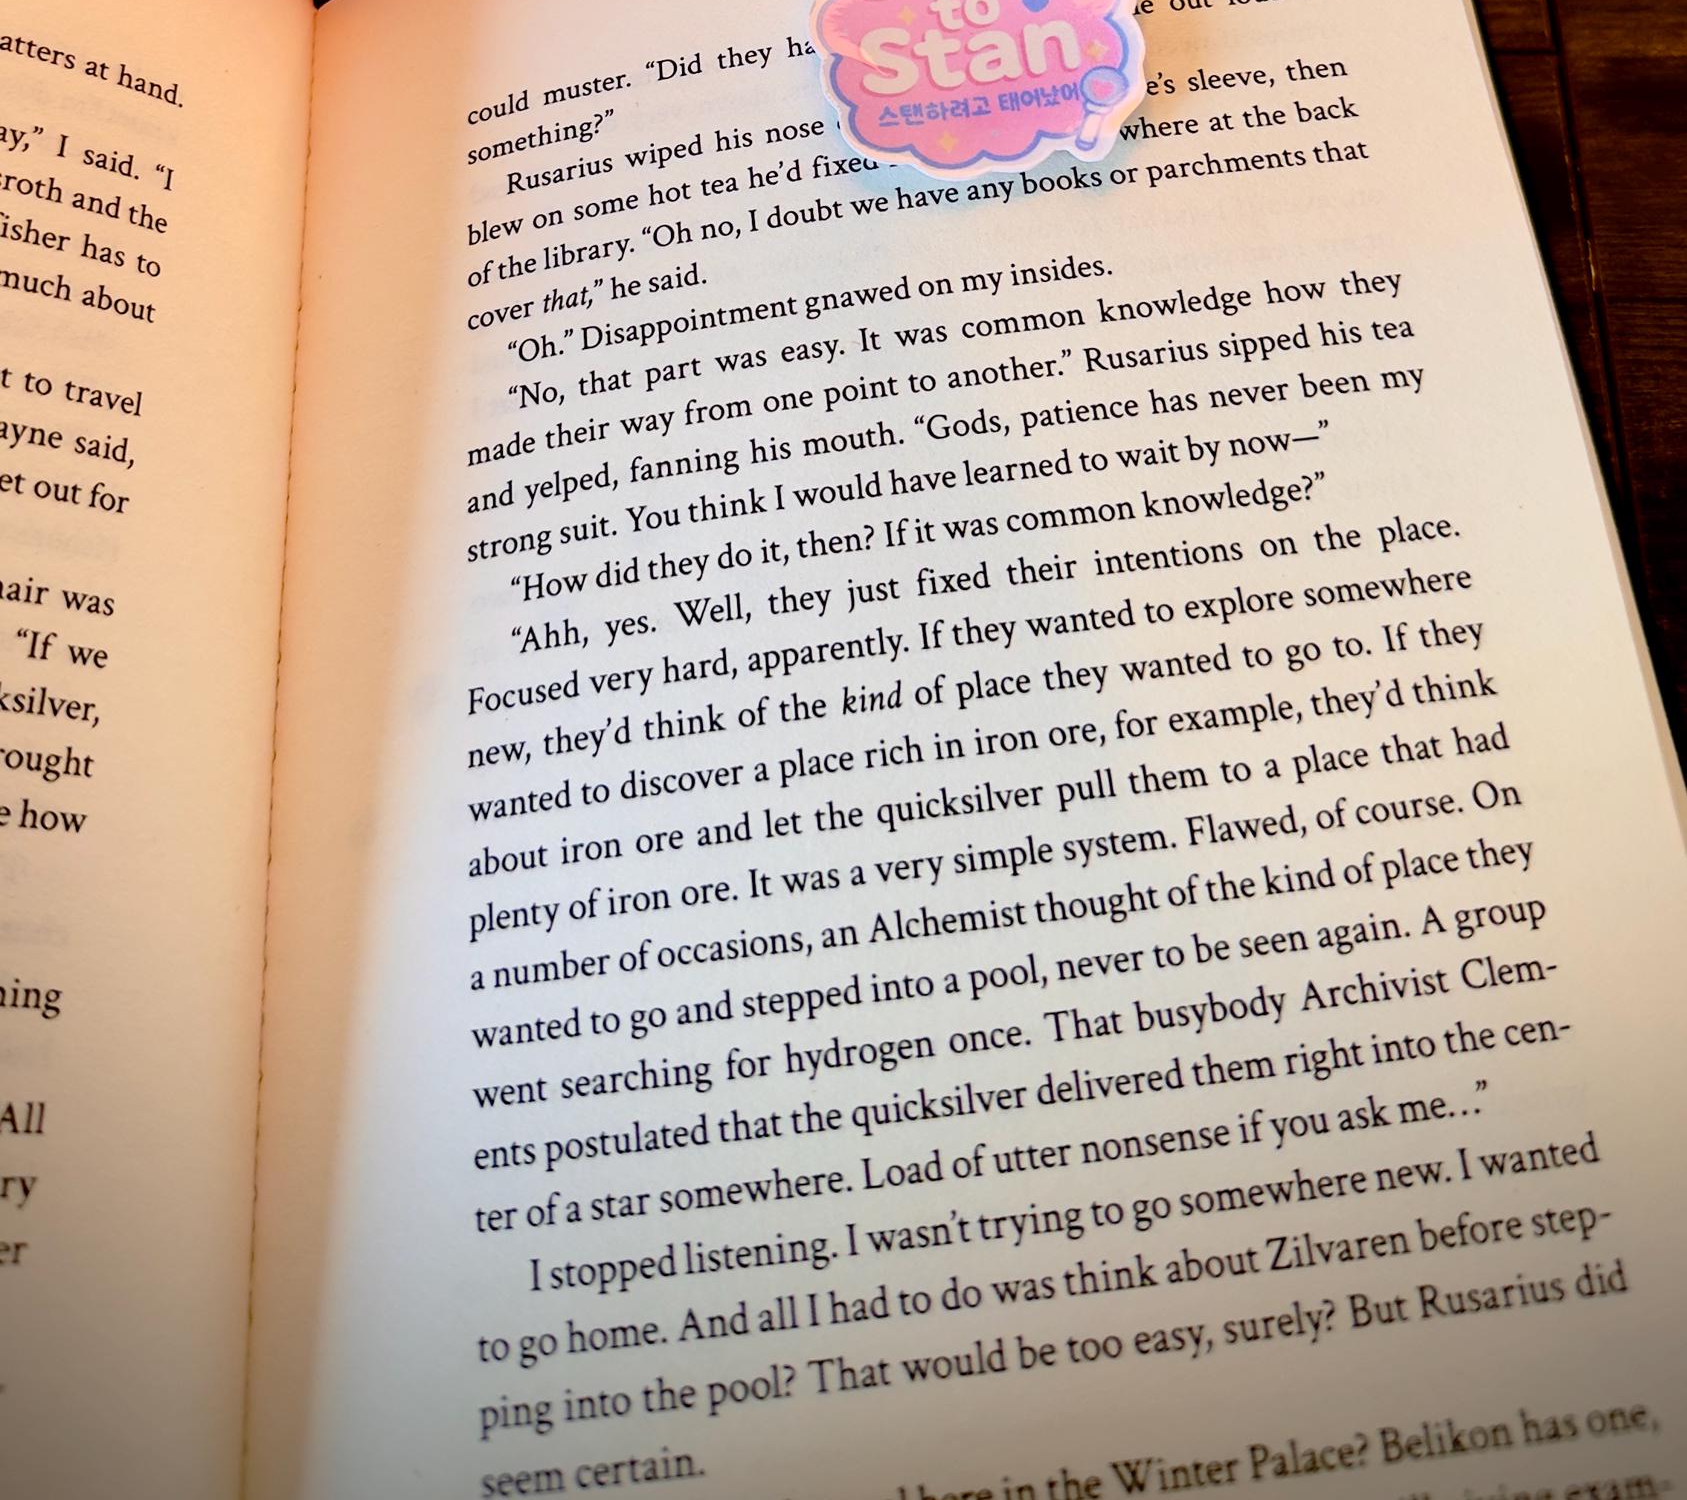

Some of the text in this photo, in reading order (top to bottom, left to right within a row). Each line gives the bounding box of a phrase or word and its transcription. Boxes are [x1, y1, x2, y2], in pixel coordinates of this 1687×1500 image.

[85, 60, 110, 81] at
[117, 63, 184, 108] hand.
[468, 90, 529, 125] could
[544, 74, 631, 105] muster.
[646, 53, 702, 81] “Did
[718, 47, 772, 69] they
[860, 20, 1082, 96] Stan
[508, 156, 614, 196] Rusarius
[625, 134, 703, 169] wiped
[715, 130, 752, 152] his
[765, 119, 825, 145] nose
[1188, 69, 1274, 91] sleeve,
[1286, 59, 1348, 81] then
[879, 82, 1080, 127] 스탠하려고 태어났어
[57, 134, 69, 158] I
[83, 149, 140, 180] said.
[155, 162, 175, 191] “I
[468, 109, 614, 166] something?”
[467, 218, 523, 246] blew
[533, 210, 563, 229] on
[574, 195, 638, 220] some
[648, 183, 691, 206] hot
[701, 177, 739, 196] tea
[747, 159, 802, 189] he’d
[1209, 113, 1234, 131] at
[1242, 105, 1286, 128] the
[1293, 96, 1359, 122] back
[72, 192, 122, 219] and
[128, 204, 168, 233] the
[468, 140, 1369, 287] of the library. “Oh no, I doubt we have any books or parchments that
[0, 212, 161, 277] isher has to
[0, 268, 156, 323] much about
[468, 262, 706, 330] cover that,” he said.
[508, 255, 1112, 362] “Oh.” Disappointment gnawed on my insides.
[24, 372, 52, 396] to
[65, 380, 143, 417] travel
[468, 321, 1414, 466] made their way from one point to another.” Rusarius sipped his tea
[74, 435, 135, 470] said,
[34, 479, 82, 505] out
[89, 482, 130, 514] for
[62, 589, 115, 617] was
[512, 516, 1460, 653] “Ahh, yes. Well, they just fixed their intentions on the place.
[17, 628, 108, 669] “If we
[0, 746, 95, 783] ought
[19, 798, 88, 833] how
[473, 956, 1557, 1108] went searching for hydrogen once. That busybody Archivist Clem-
[481, 1259, 1628, 1440] ping into the pool? That would be too easy, surely? But Rusarius did
[483, 1446, 704, 1498] seem certain.
[1046, 1466, 1102, 1500] the
[1111, 1457, 1239, 1495] Winter
[1249, 1433, 1370, 1481] Palace?
[1378, 1418, 1514, 1465] Belikon
[1518, 1406, 1579, 1443] has
